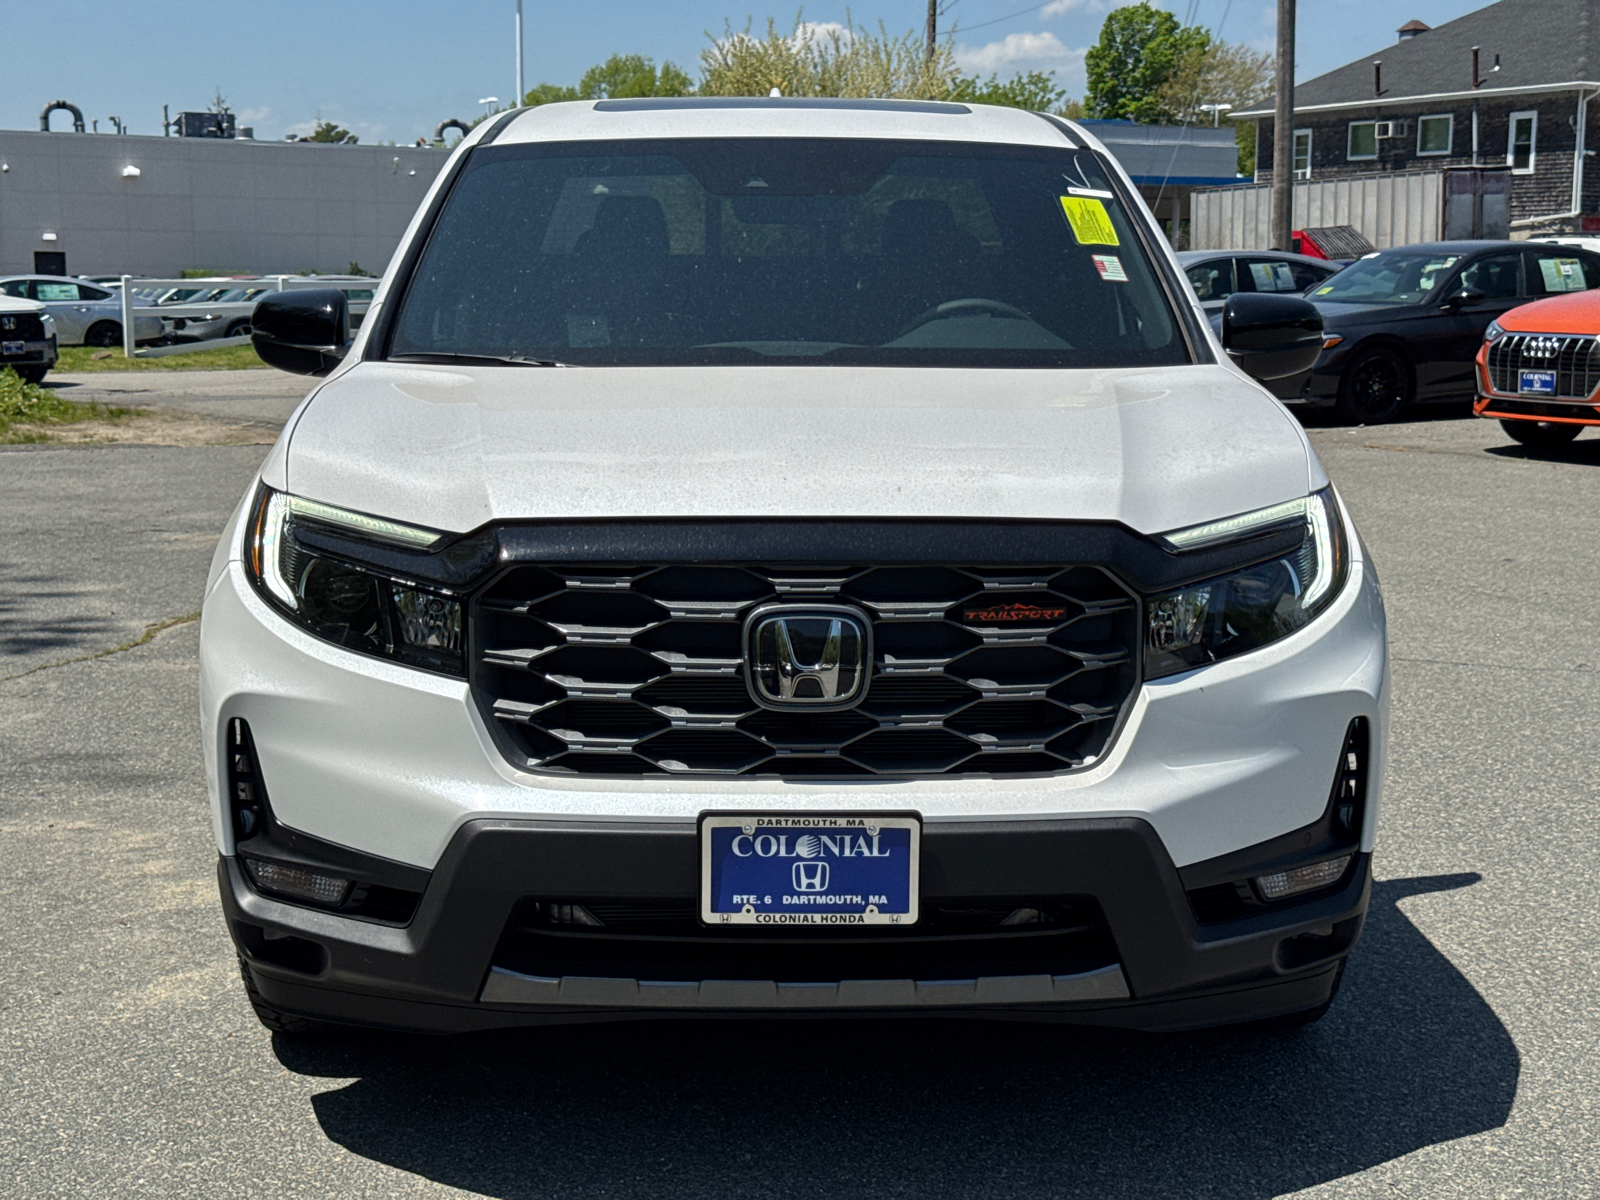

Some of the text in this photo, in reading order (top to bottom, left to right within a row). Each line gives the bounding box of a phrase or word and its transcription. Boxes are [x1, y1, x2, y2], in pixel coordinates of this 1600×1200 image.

[966, 609, 1064, 620] TRAILSPORT
[846, 818, 865, 827] MA
[731, 834, 890, 858] COLONIAL
[732, 895, 888, 905] RTE. 6 DARTMOUTH, MA
[755, 914, 865, 923] COLONIAL HONDA
